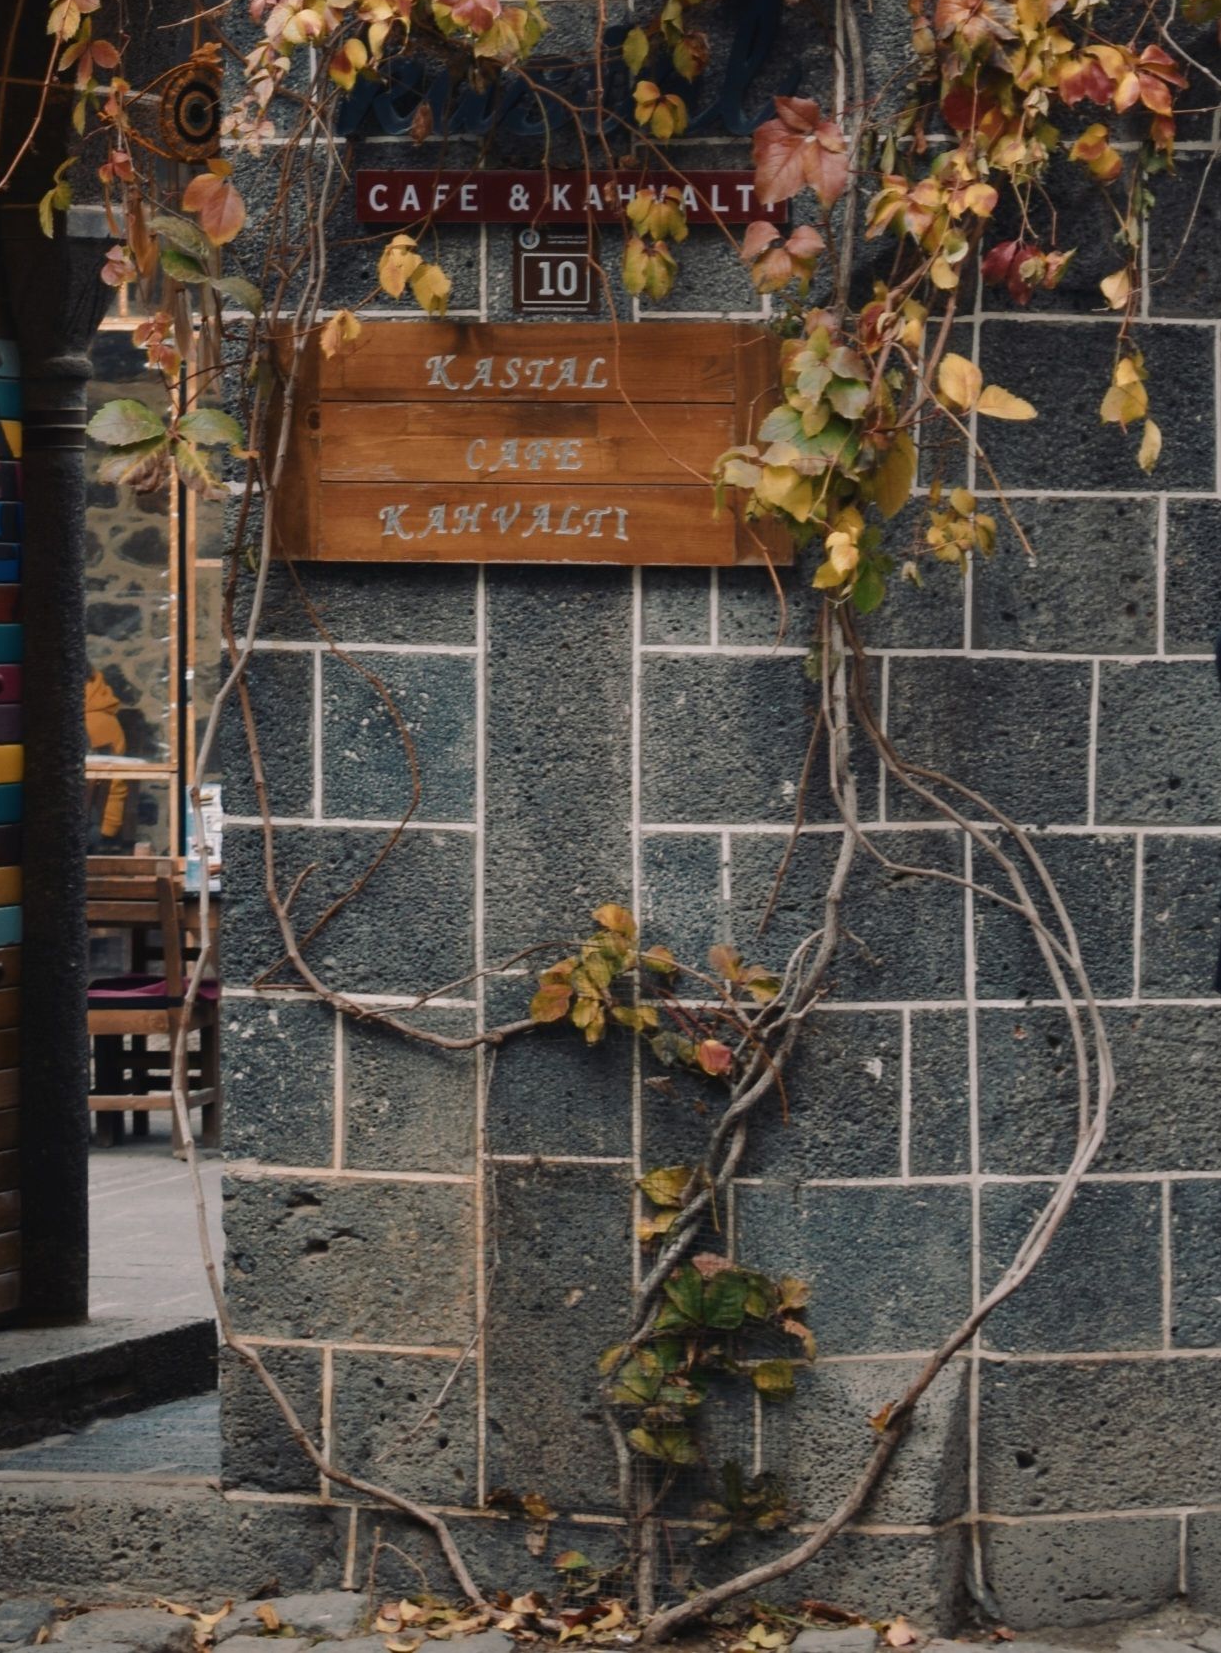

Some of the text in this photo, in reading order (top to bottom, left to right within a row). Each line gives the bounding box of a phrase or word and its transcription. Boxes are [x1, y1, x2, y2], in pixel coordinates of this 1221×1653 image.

[368, 183, 776, 213] CAFE & KAHVALT
[538, 260, 578, 296] 10
[425, 354, 608, 390] KASTAL
[466, 438, 583, 472] CAFE
[379, 502, 629, 541] KAHVALTI
